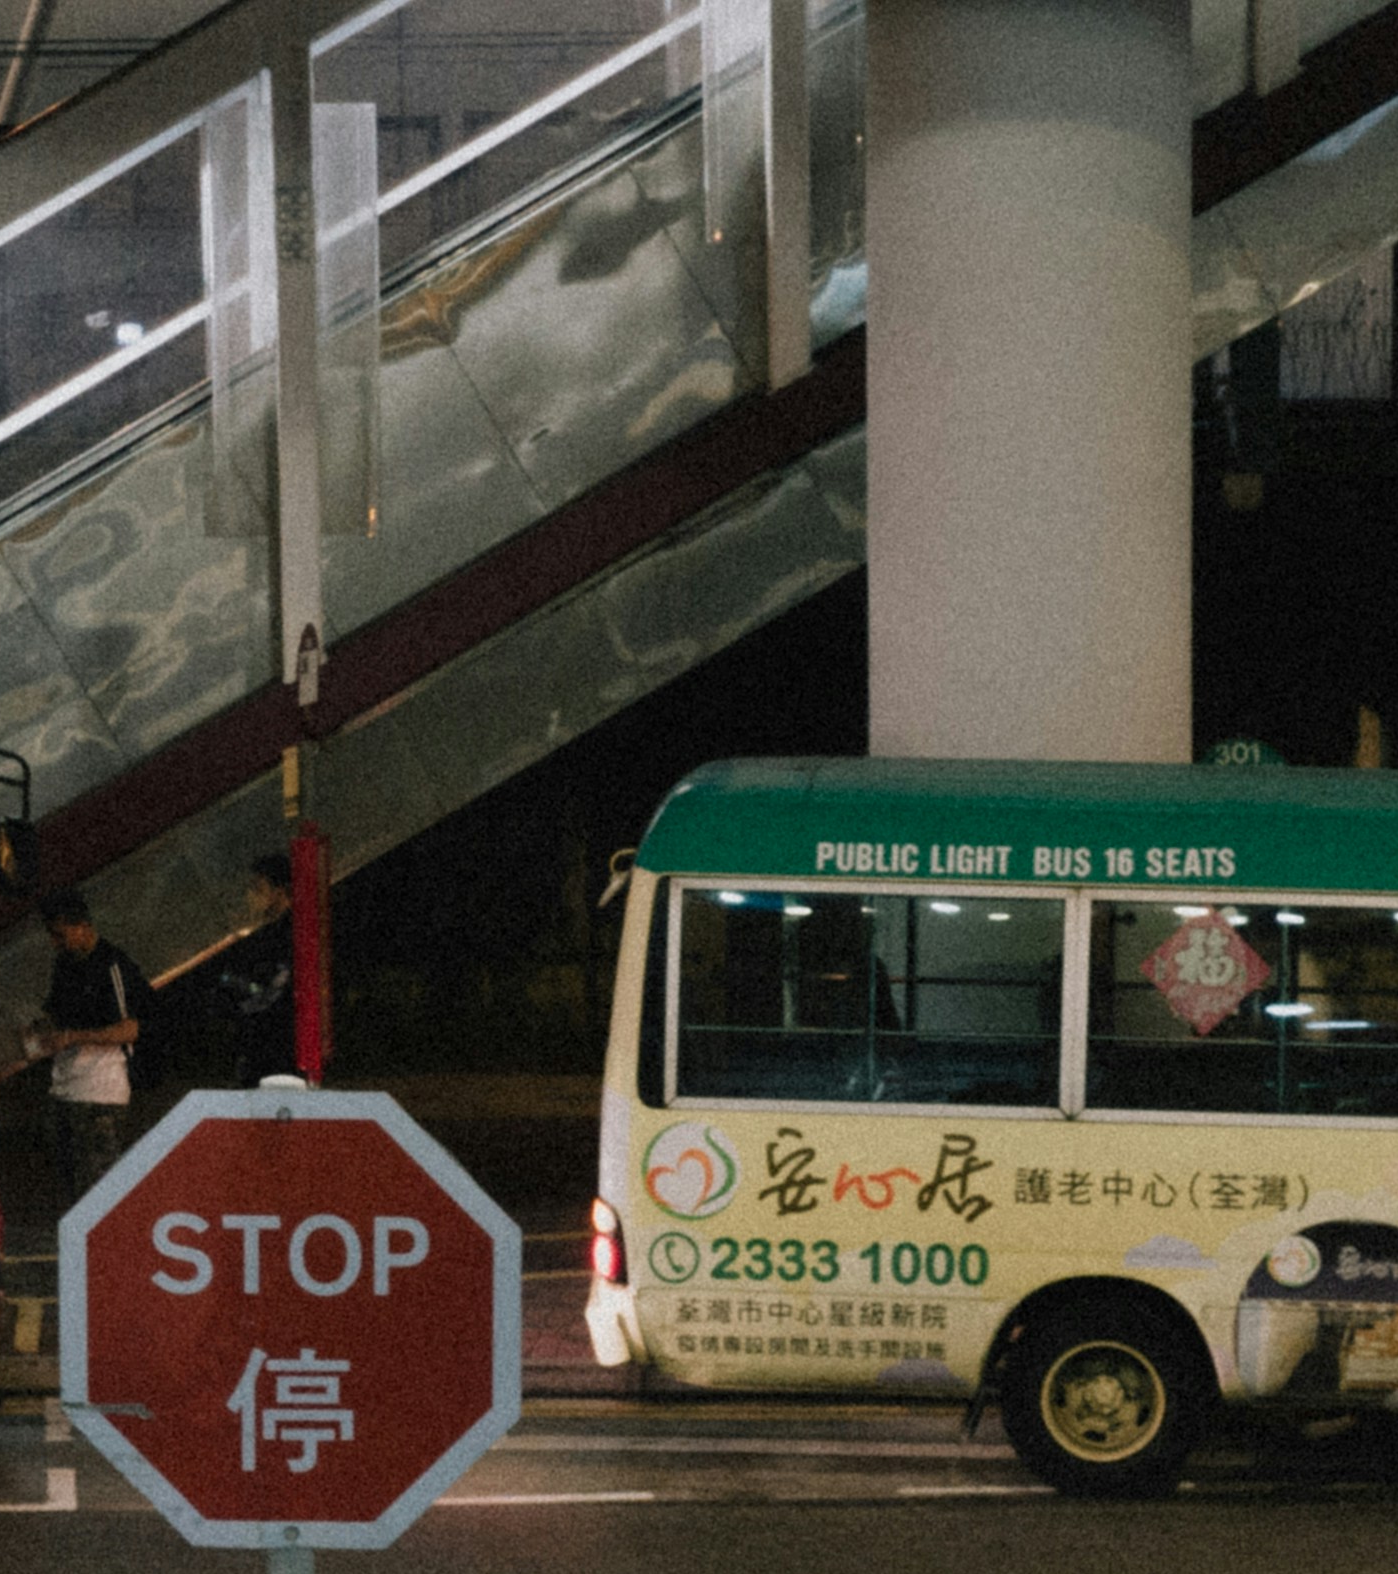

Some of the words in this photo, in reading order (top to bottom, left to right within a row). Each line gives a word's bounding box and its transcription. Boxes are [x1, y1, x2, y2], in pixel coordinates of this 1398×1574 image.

[1215, 742, 1262, 766] 301
[815, 841, 919, 874] PUBLIC
[930, 844, 1013, 875] LIGHT
[1033, 847, 1092, 877] BUS
[1104, 848, 1135, 878] 16
[1146, 847, 1237, 878] SEATS
[1174, 926, 1236, 987] 福
[757, 1126, 995, 1224] 安心居
[150, 1211, 431, 1298] STOP
[709, 1236, 840, 1284] 2333
[859, 1241, 991, 1287] 1000
[226, 1347, 355, 1474] 停
